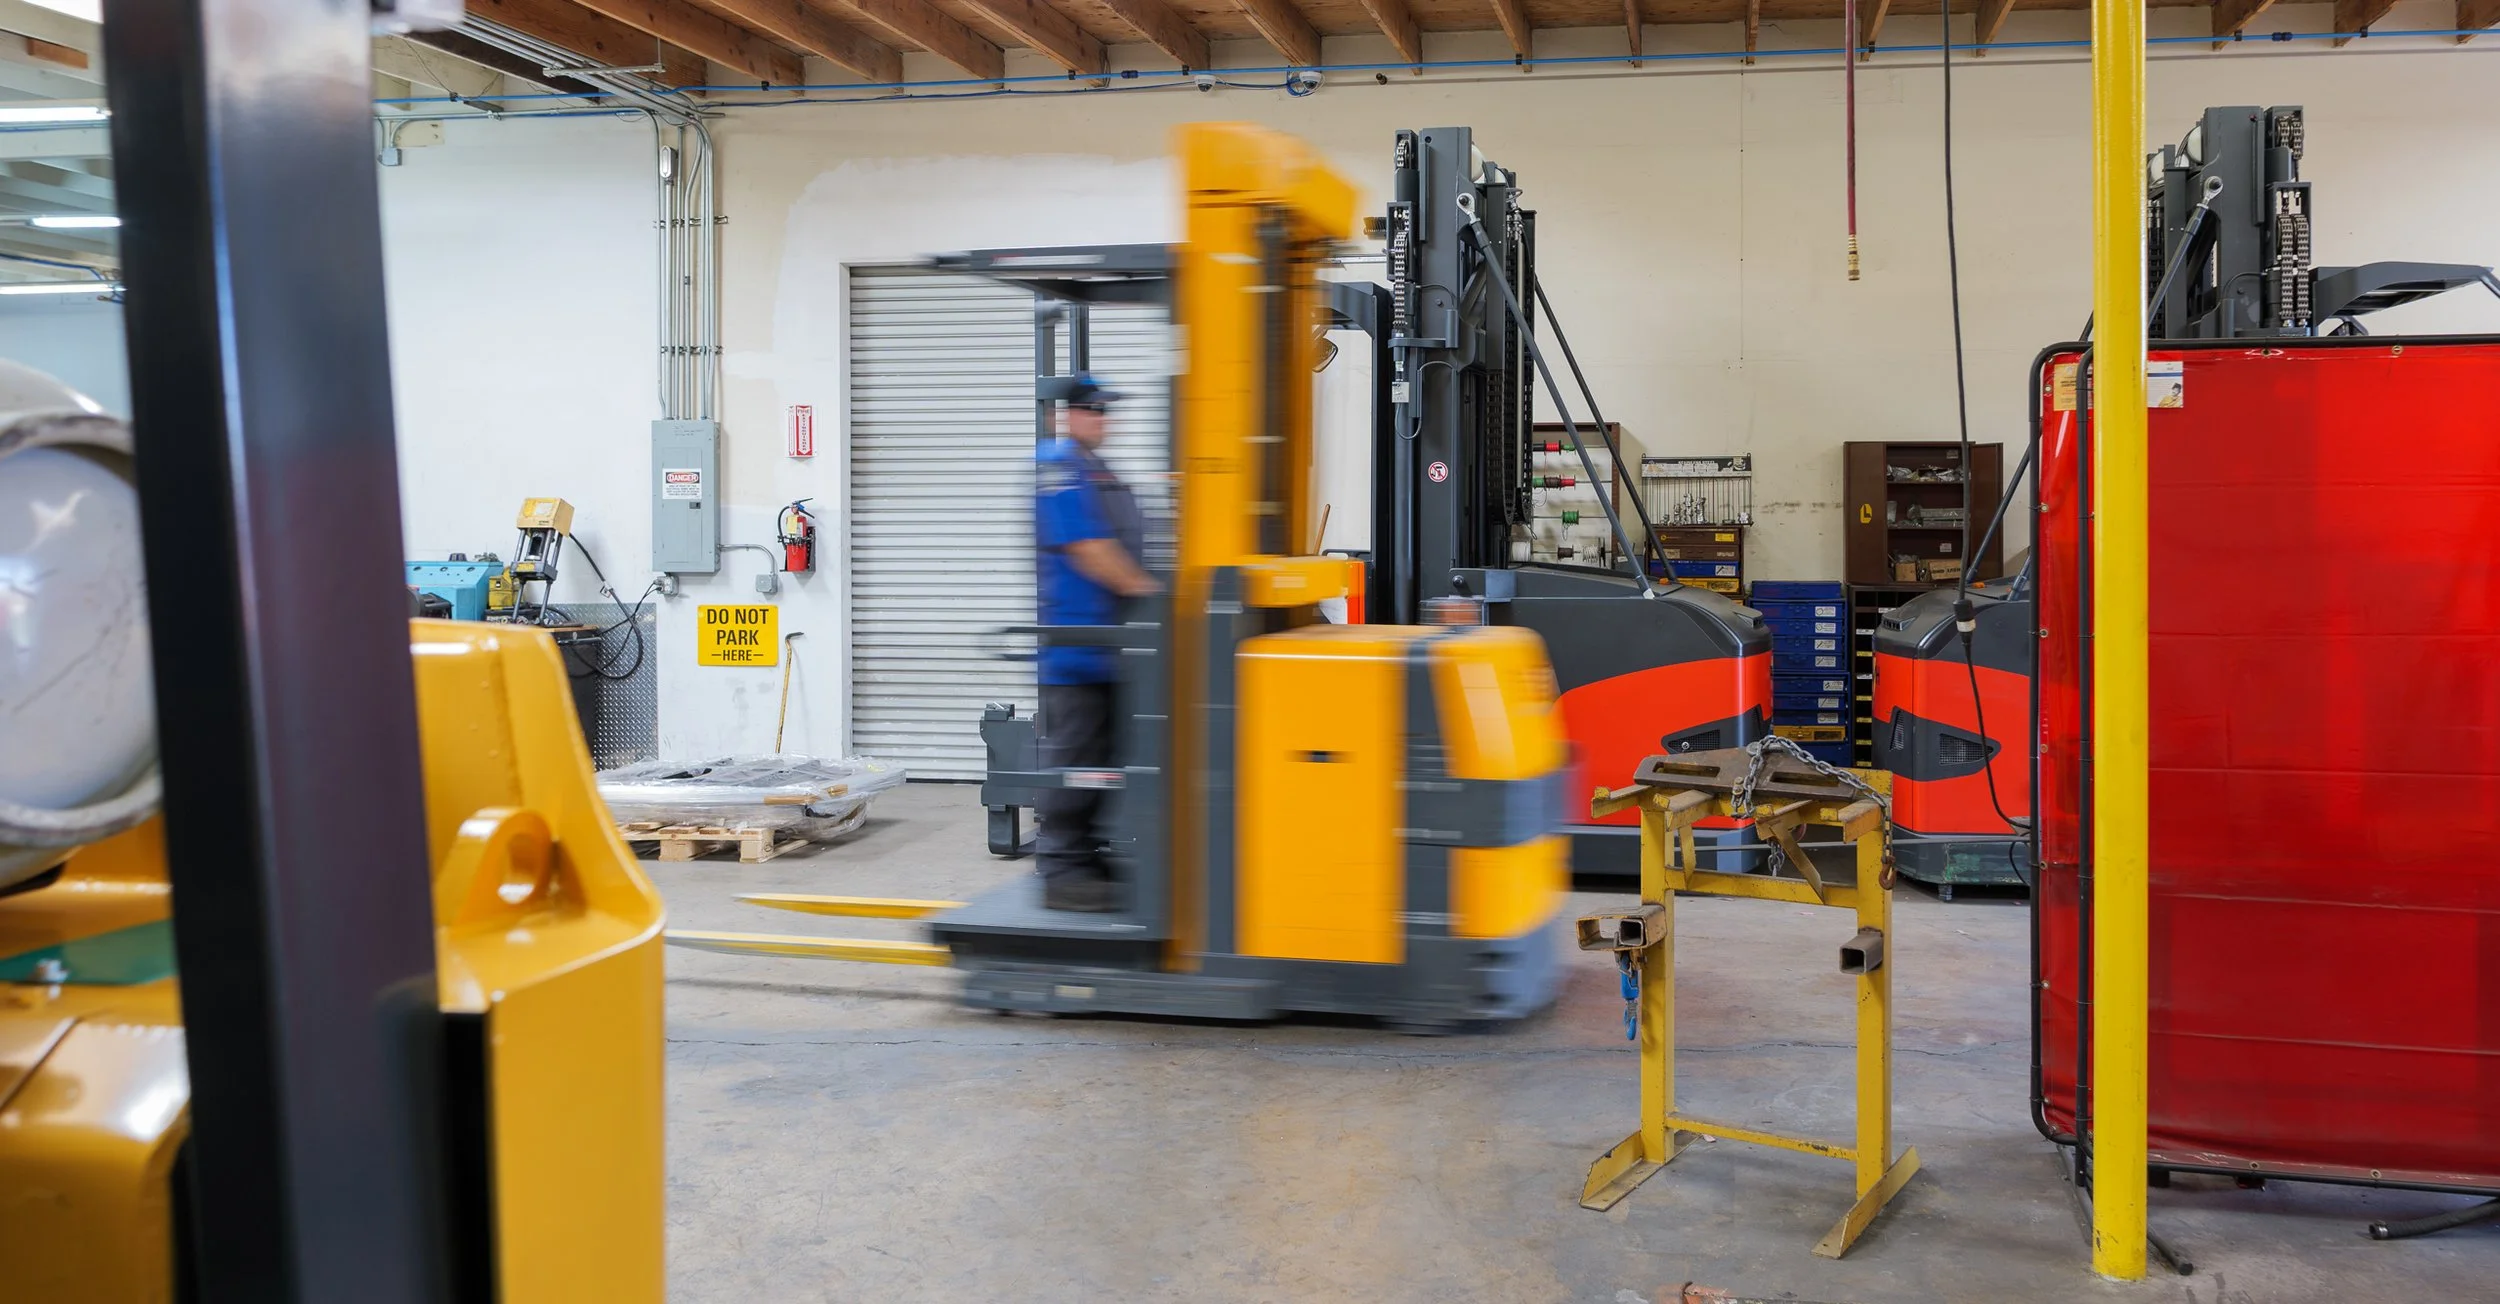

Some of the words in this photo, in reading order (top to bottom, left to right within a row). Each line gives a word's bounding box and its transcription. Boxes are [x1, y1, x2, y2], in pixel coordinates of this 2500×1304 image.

[669, 473, 697, 482] DANGER
[707, 608, 729, 625] DO
[735, 608, 769, 625] NOT
[716, 629, 759, 646] PARK
